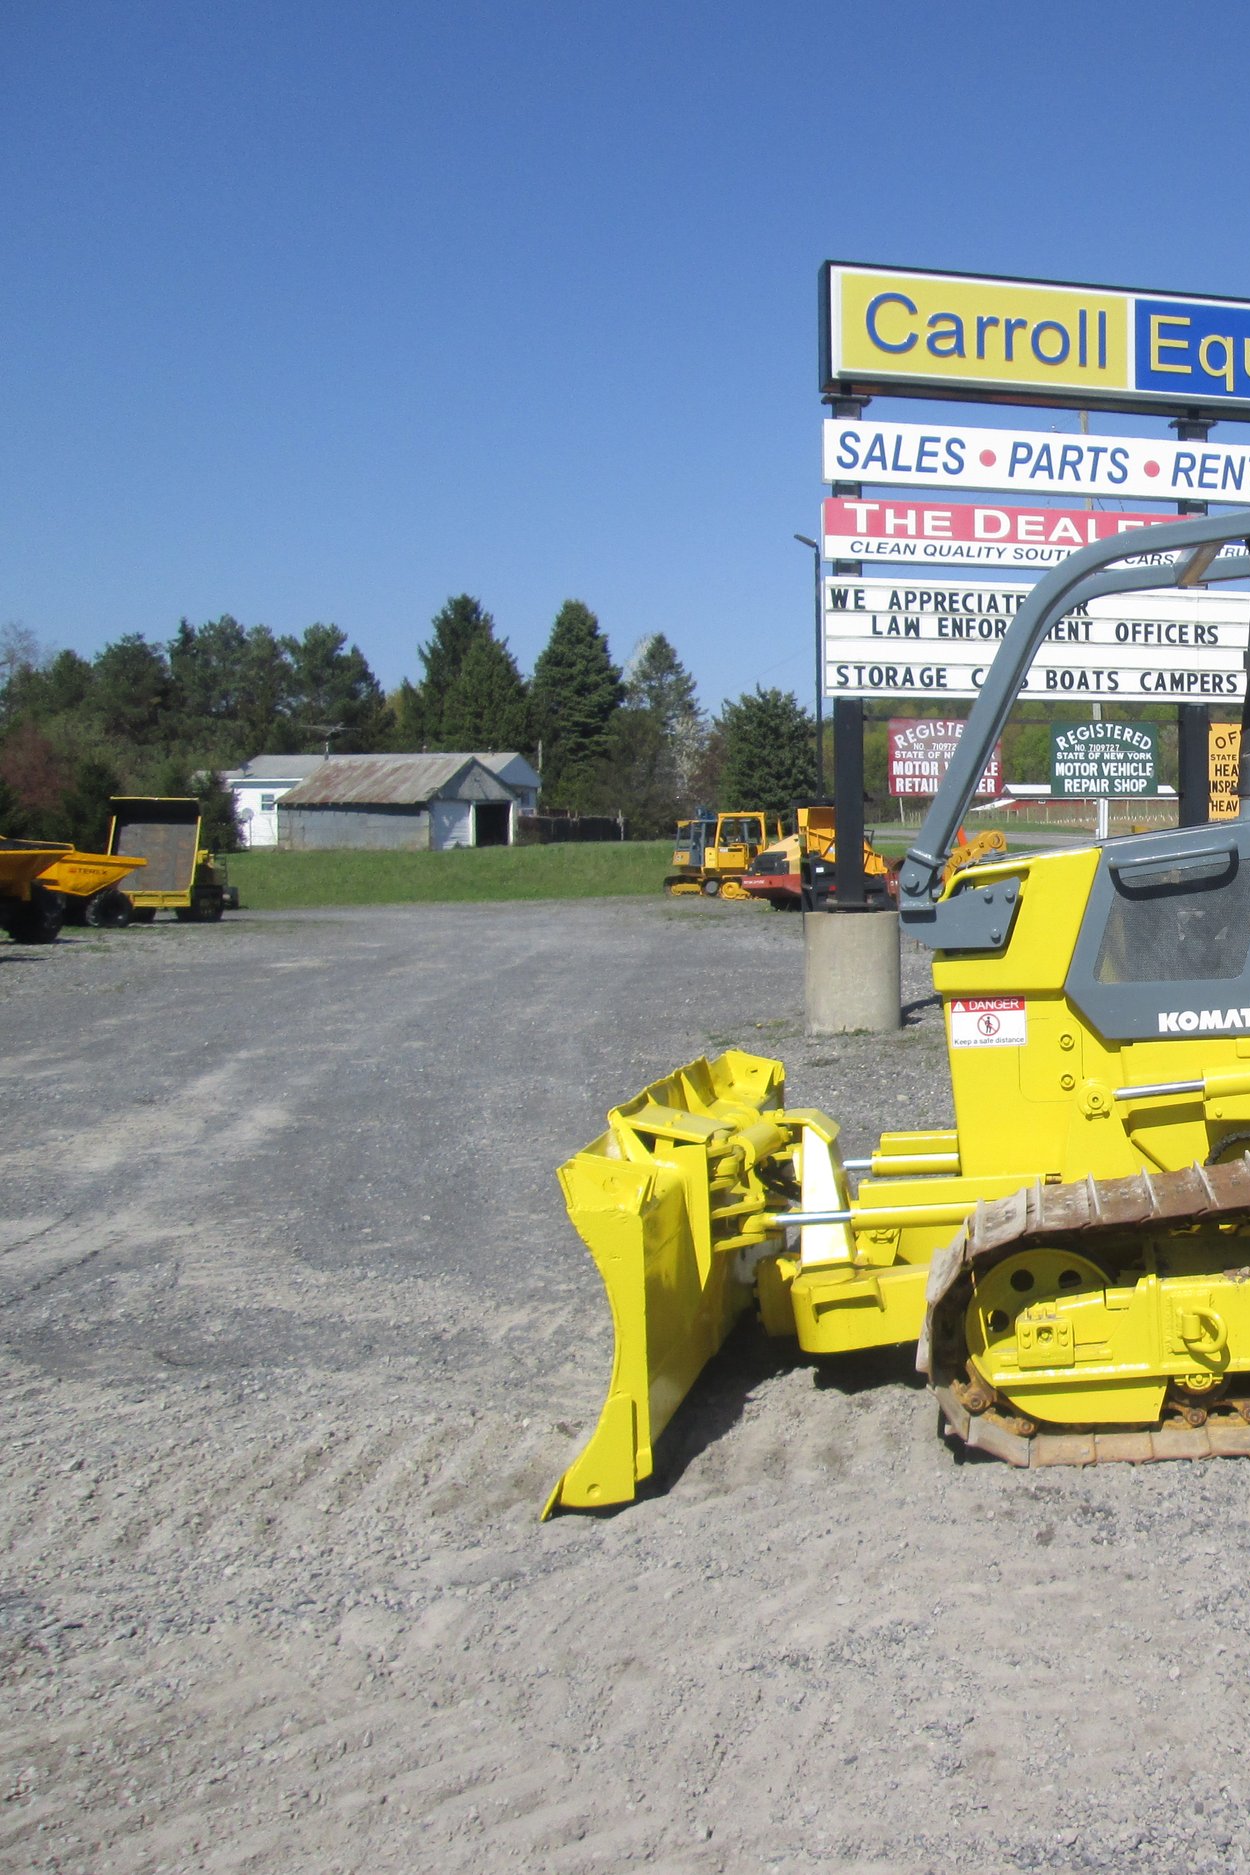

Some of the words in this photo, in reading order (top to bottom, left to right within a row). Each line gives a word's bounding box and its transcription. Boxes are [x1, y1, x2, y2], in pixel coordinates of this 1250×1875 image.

[866, 292, 1107, 369] Carroll
[836, 430, 966, 476] SALES
[1008, 441, 1130, 485] PARTS
[843, 502, 953, 538] THE
[850, 540, 917, 556] CLEAN
[923, 543, 1008, 560] QUALITY
[830, 588, 866, 610] WE
[872, 615, 920, 638] LAW
[938, 616, 1094, 642] ENFORENT
[1115, 622, 1219, 645] OFFICERS
[836, 664, 948, 688] STORAGE
[1045, 669, 1120, 691] BOATS
[1140, 671, 1238, 694] CAMPERS
[894, 721, 965, 749] REGISTE
[1055, 723, 1152, 751] REGISTERED
[894, 751, 925, 759] STATE
[927, 751, 941, 759] OF
[1056, 751, 1085, 760] STATE
[1088, 751, 1102, 760] OF
[1104, 752, 1125, 760] NEW
[1127, 752, 1153, 760] YORK
[1088, 743, 1120, 752] 7109727
[1210, 753, 1238, 761] STATE
[893, 760, 939, 776] MOTOR
[1055, 762, 1098, 777] MOTOR
[1101, 762, 1154, 777] VEHICLE
[895, 777, 939, 793] RETAIL
[1064, 778, 1110, 793] REPAIR
[1113, 778, 1148, 793] SHOP
[1211, 800, 1239, 812] HEAV
[968, 998, 1020, 1011] DANGER
[954, 1038, 972, 1046] Keep
[979, 1037, 994, 1045] safe
[995, 1036, 1025, 1044] distance
